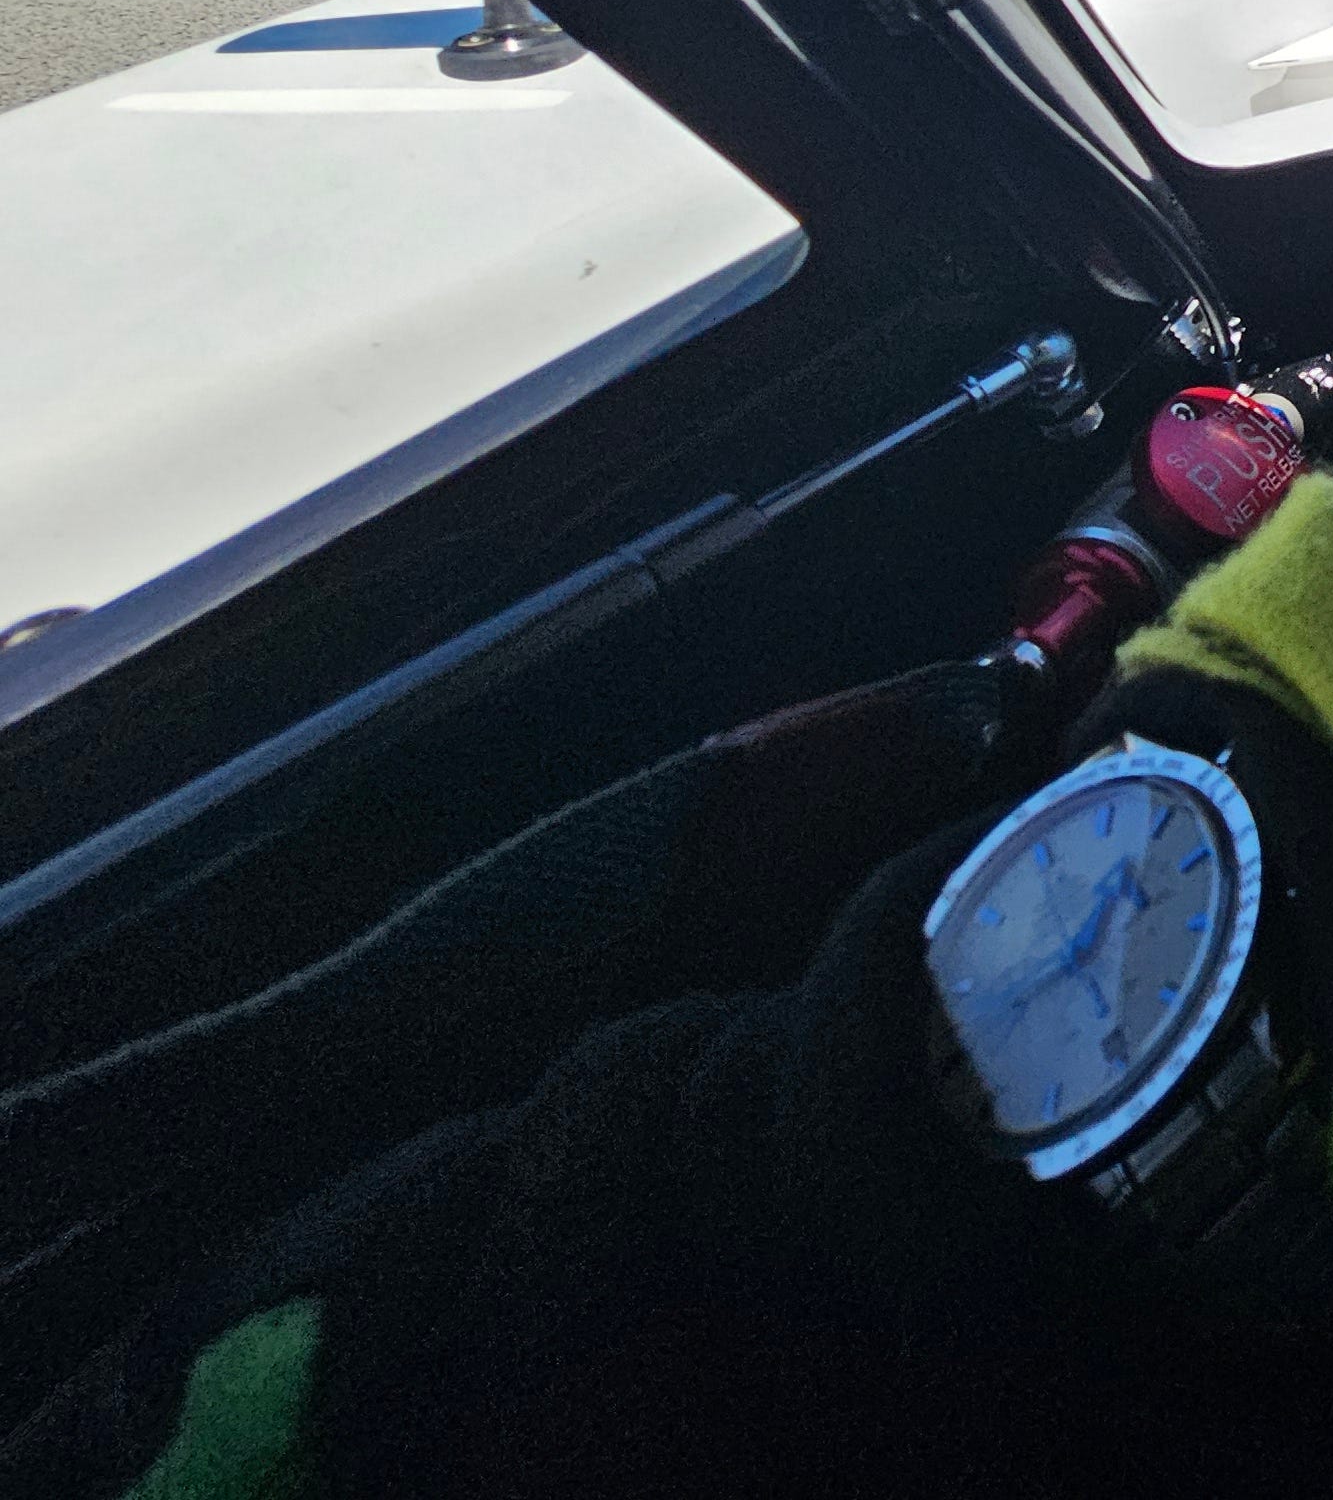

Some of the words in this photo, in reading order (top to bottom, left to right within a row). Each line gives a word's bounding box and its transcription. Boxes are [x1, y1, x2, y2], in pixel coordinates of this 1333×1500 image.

[1187, 410, 1292, 512] PUSH
[1223, 497, 1260, 533] NET
[1258, 447, 1306, 506] RELEASE
